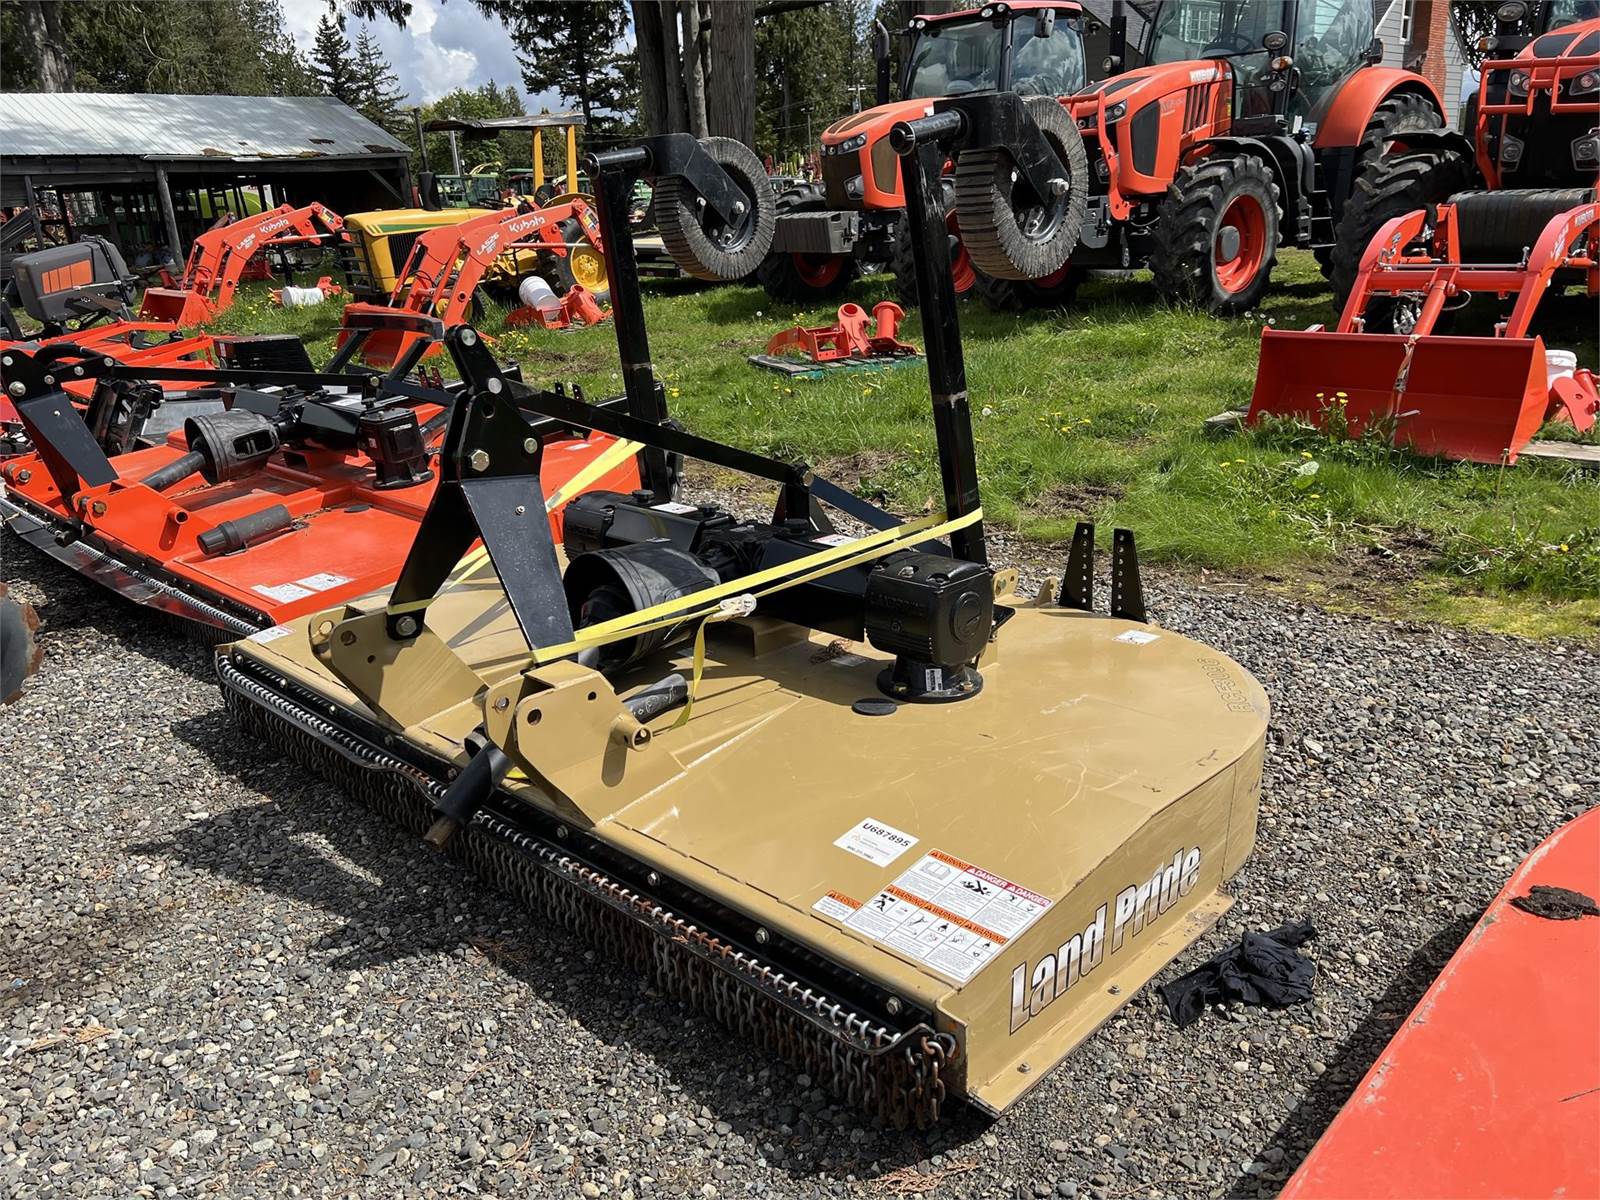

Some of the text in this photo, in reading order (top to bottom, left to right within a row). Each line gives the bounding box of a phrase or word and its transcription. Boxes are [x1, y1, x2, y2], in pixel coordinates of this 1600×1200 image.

[259, 218, 289, 234] Kubota
[509, 214, 546, 233] Kubota
[862, 822, 912, 848] U687895
[938, 853, 970, 872] WARNING
[974, 867, 1008, 889] DANGER
[1014, 886, 1051, 909] DANGER
[970, 922, 1008, 946] WARNING
[1009, 846, 1201, 1036] Land Pride
